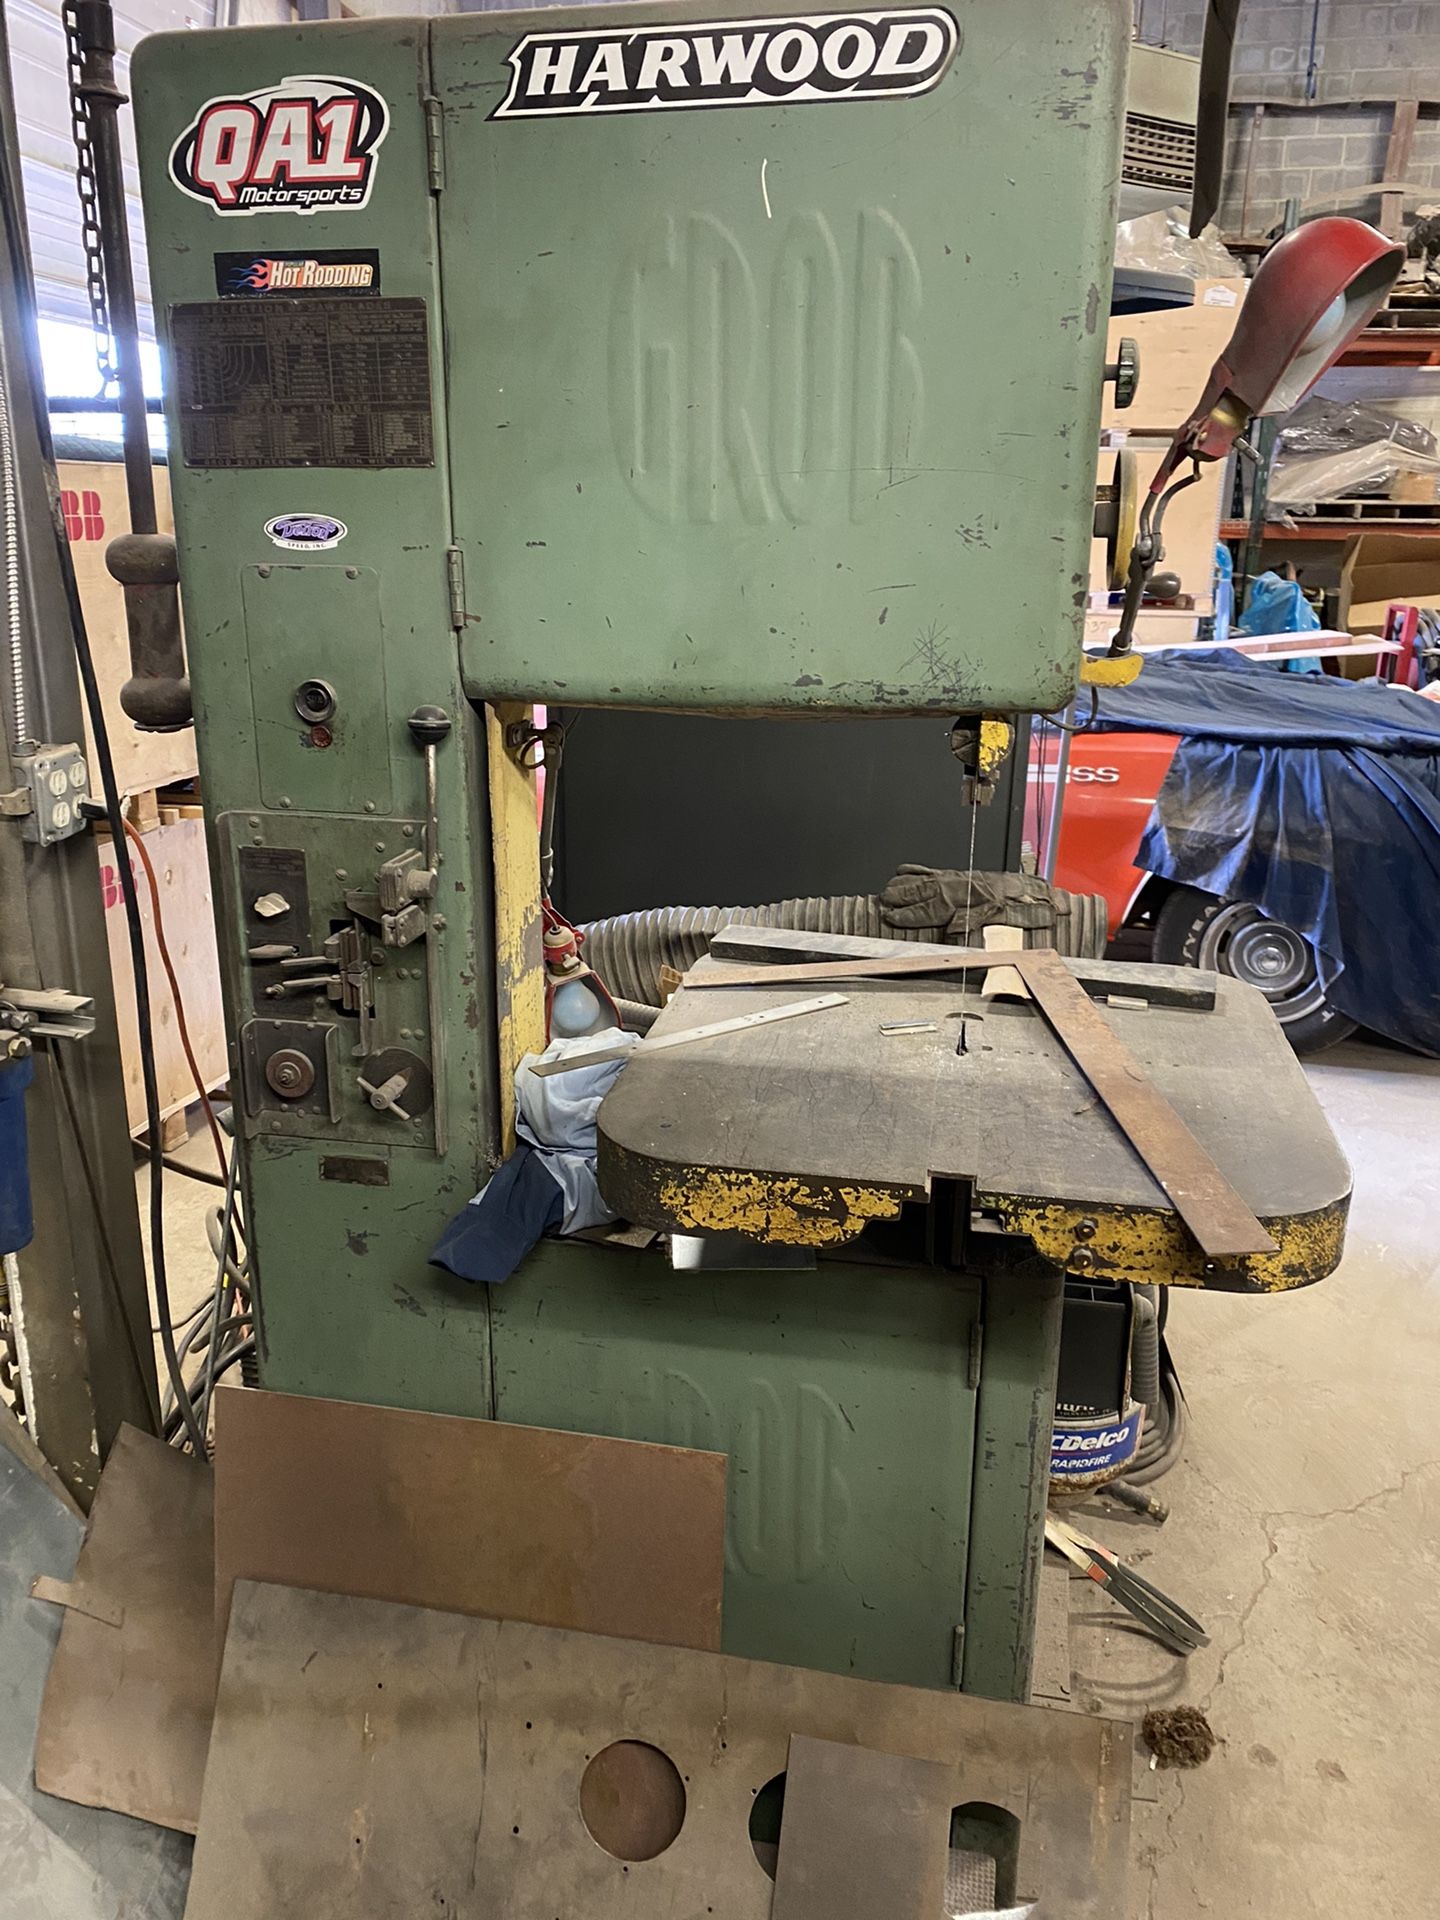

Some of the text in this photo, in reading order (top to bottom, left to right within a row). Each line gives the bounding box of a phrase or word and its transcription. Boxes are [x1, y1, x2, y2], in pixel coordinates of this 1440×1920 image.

[525, 22, 945, 96] HARWOOD
[194, 99, 366, 204] QA1
[239, 184, 363, 205] Motorsports
[270, 260, 371, 286] HOT RODDING
[607, 207, 925, 527] GROB
[1071, 766, 1120, 783] SS
[1051, 1453, 1113, 1469] RAPIDFIRE
